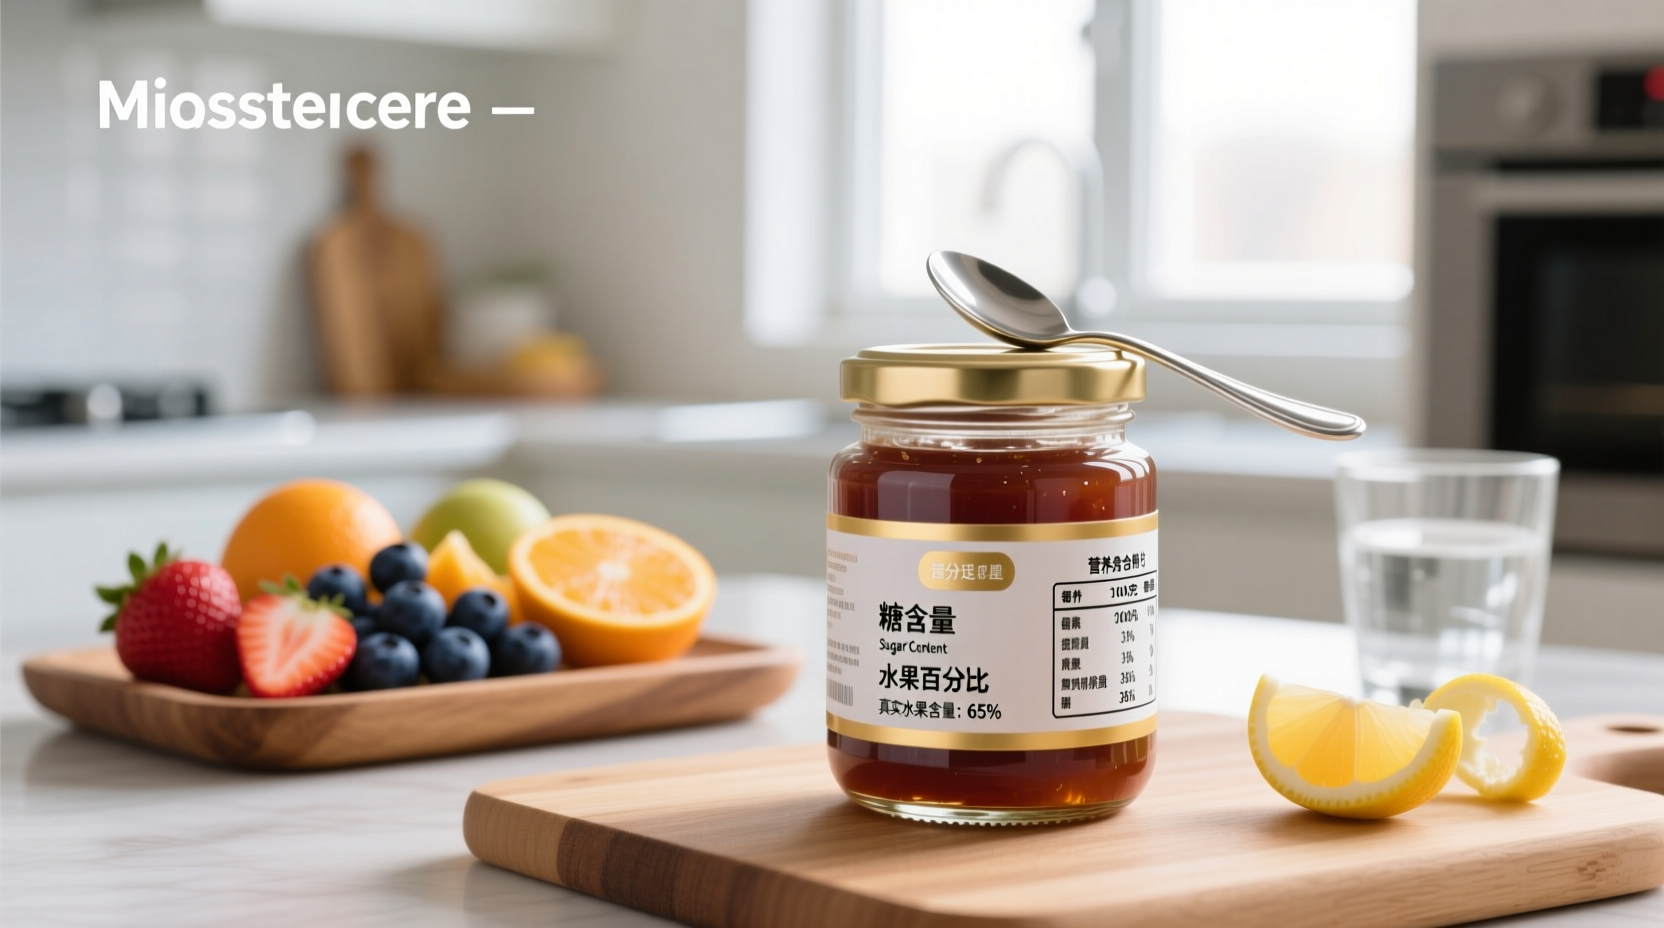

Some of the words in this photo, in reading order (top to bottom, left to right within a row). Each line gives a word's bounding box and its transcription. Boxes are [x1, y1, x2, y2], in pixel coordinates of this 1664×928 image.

[879, 601, 957, 635] 糖含量
[879, 638, 907, 656] Sugar
[879, 662, 989, 694] 水果百分比
[967, 703, 1002, 720] 65%
